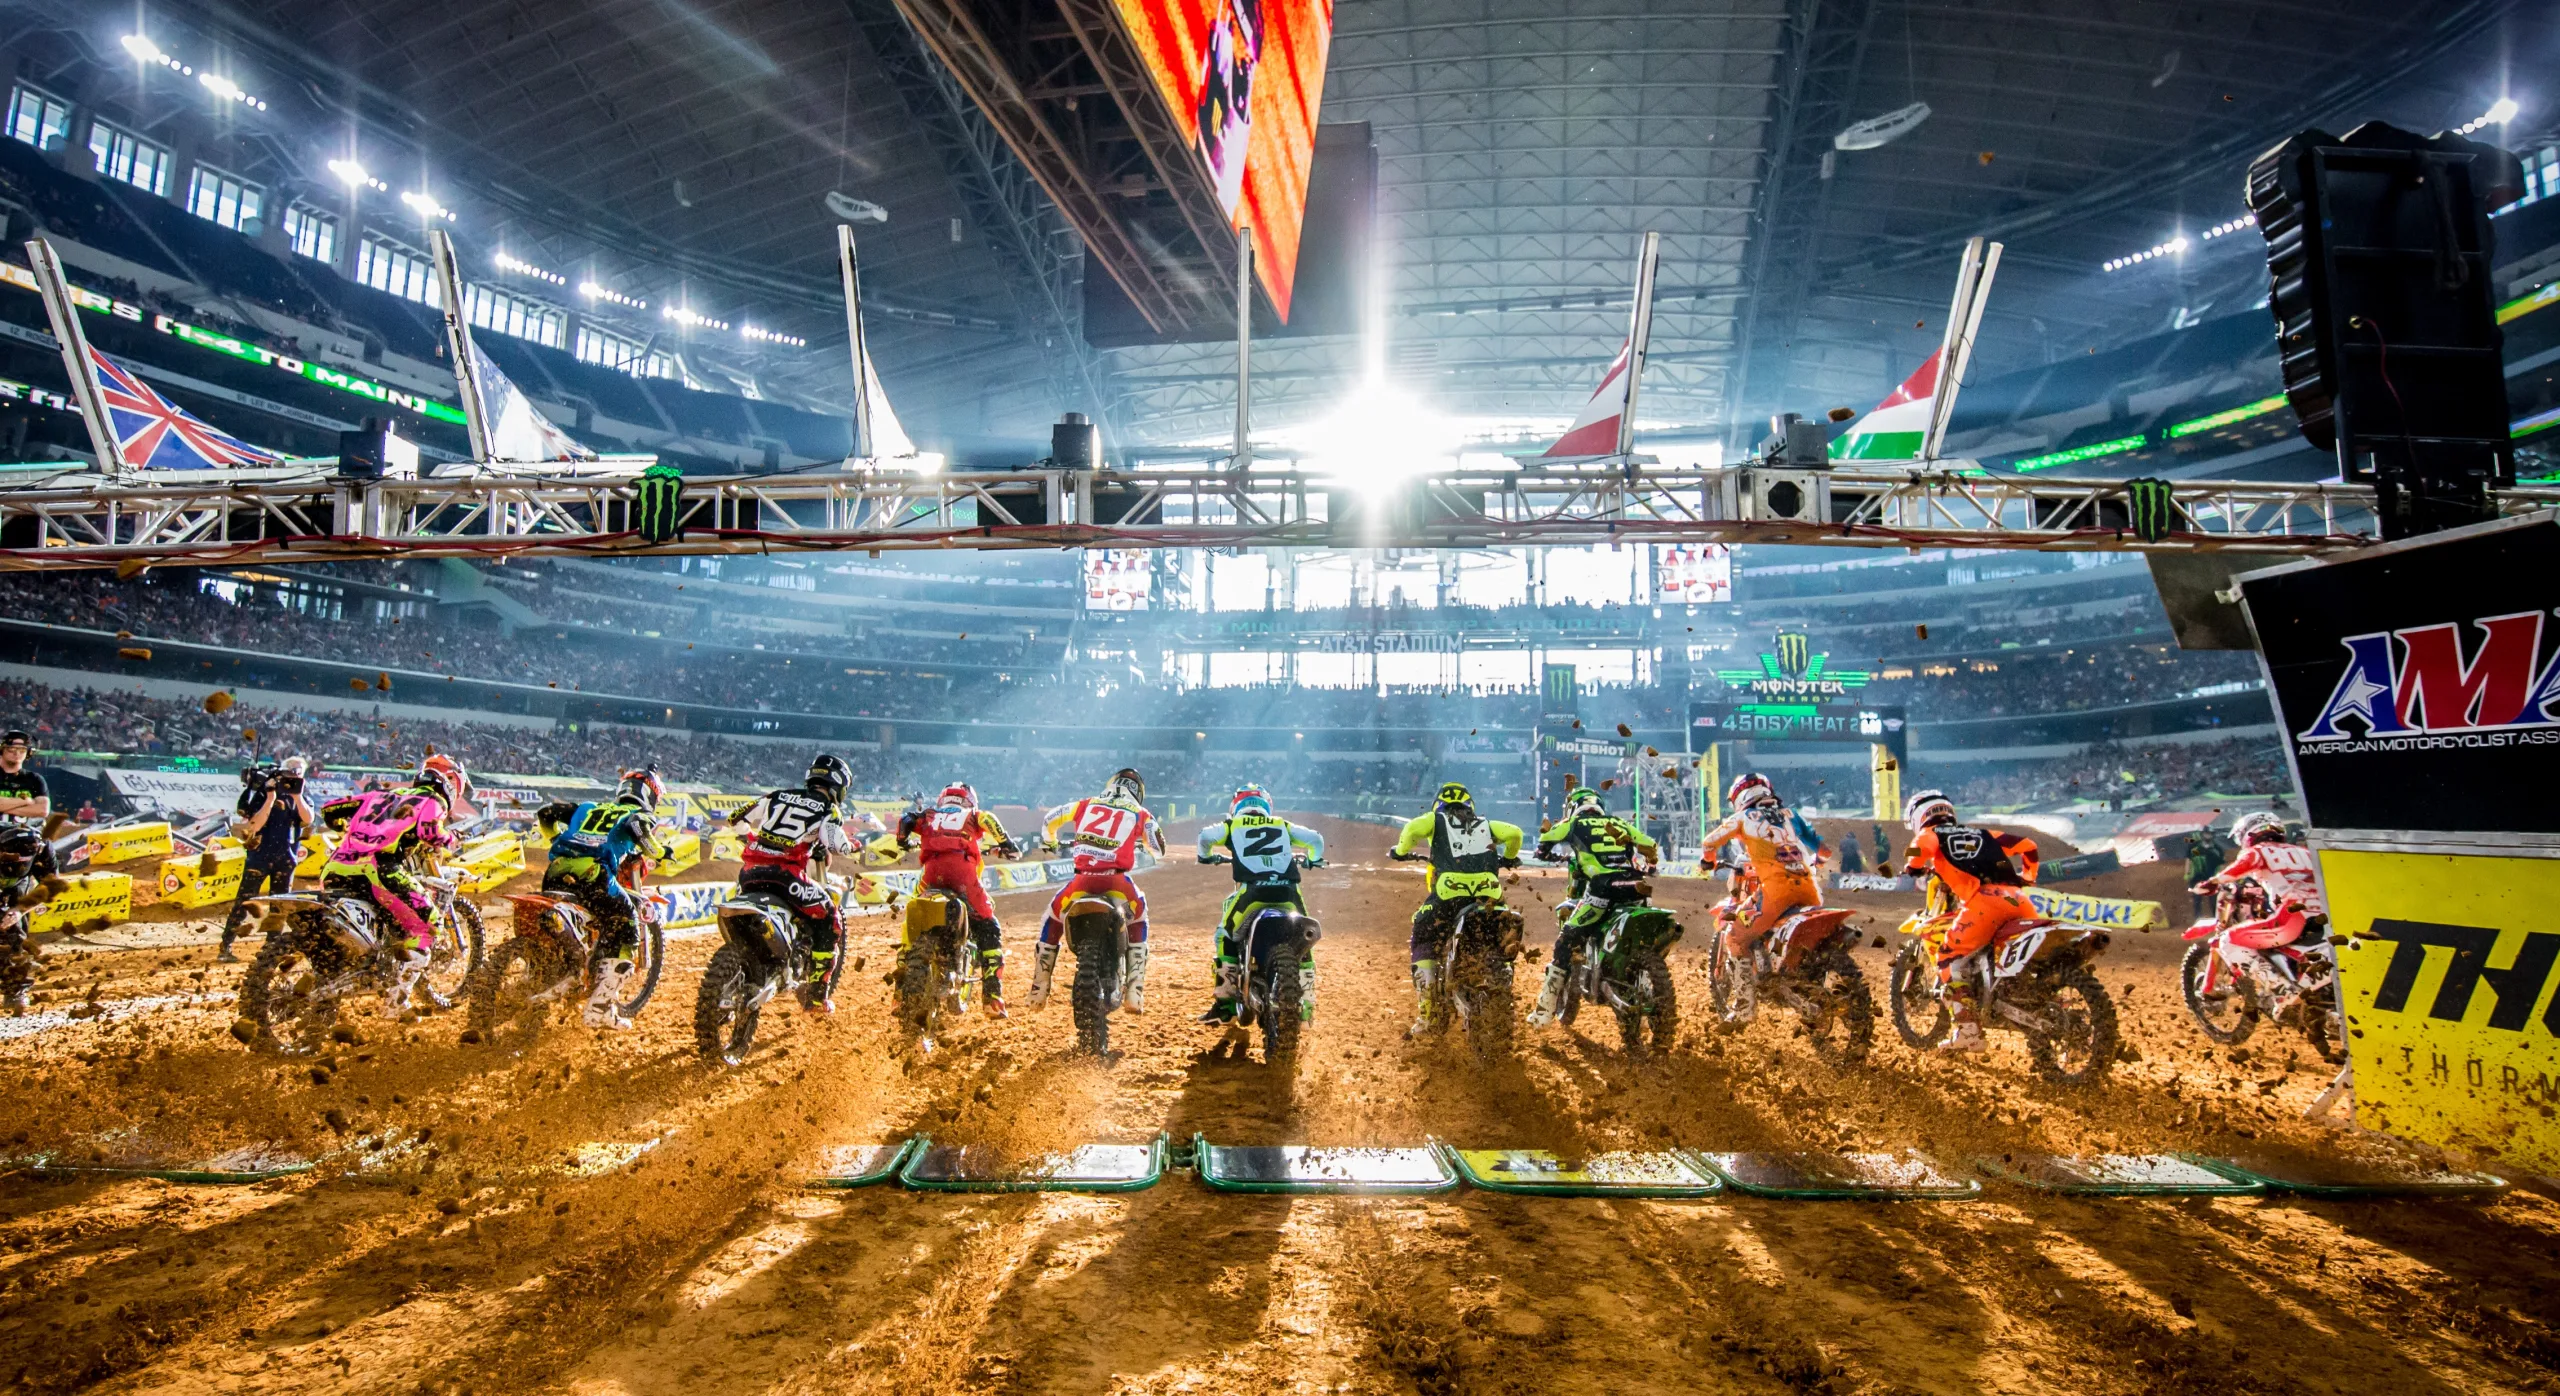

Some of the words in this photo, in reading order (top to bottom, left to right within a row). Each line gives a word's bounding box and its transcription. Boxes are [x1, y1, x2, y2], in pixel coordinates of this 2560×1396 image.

[253, 346, 304, 375] TO
[315, 367, 427, 413] MAIN]
[1319, 636, 1369, 653] AT&T
[1373, 635, 1464, 653] STADIUM
[1722, 714, 1794, 732] 450SX
[1800, 716, 1846, 732] HEAT
[1556, 741, 1626, 757] HOLESHOT
[2299, 741, 2378, 755] AMERICAN
[2379, 733, 2517, 751] MOTORCYCLIST
[1542, 761, 1548, 771] 2
[147, 780, 240, 793] Husqvarna
[476, 790, 541, 801] AMSOIL
[778, 792, 825, 812] WILSON
[580, 808, 631, 835] 18
[762, 803, 815, 839] 15
[1083, 805, 1125, 839] 21
[124, 834, 170, 848] DUNLOP
[1243, 827, 1284, 857] 2
[55, 894, 129, 913] DUNLOP
[2029, 894, 2132, 924] SUZUKI
[2367, 917, 2560, 1039] TH
